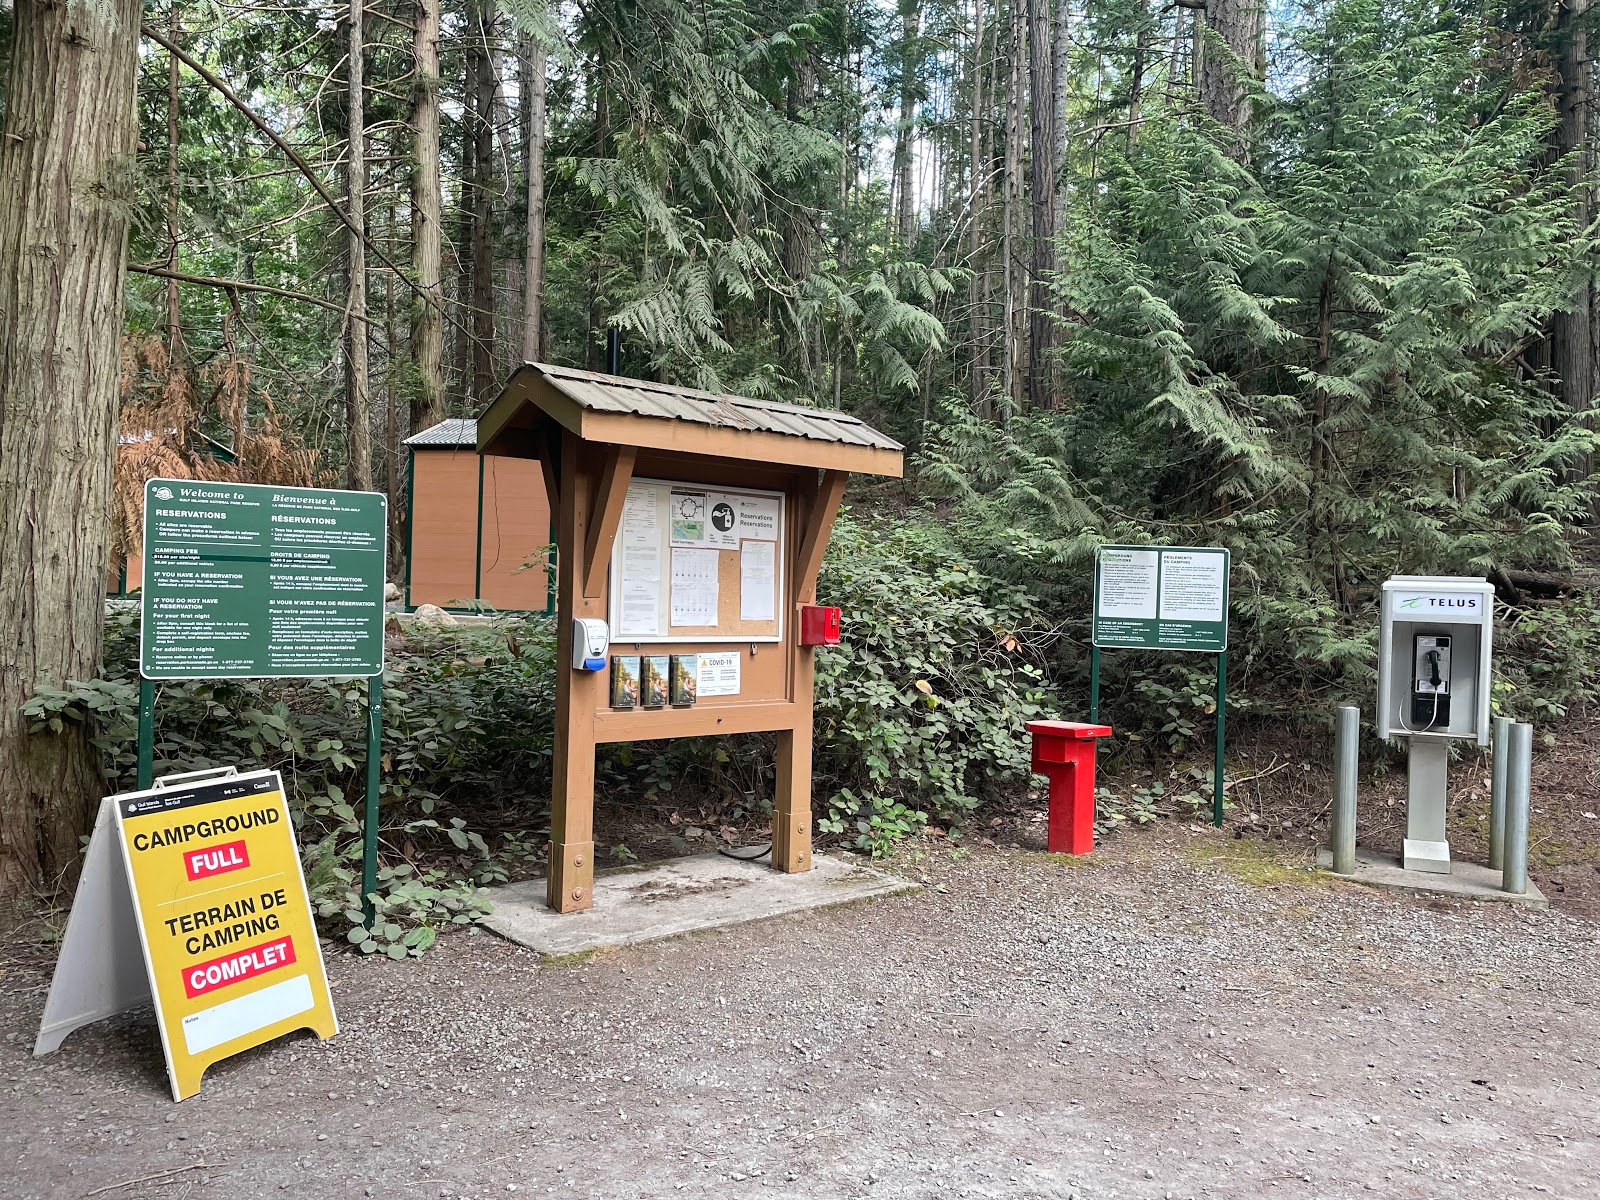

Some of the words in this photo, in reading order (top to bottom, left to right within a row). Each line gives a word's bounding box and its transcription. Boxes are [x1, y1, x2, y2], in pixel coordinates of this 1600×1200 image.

[180, 488, 230, 498] Welcome
[272, 494, 327, 504] Bienvenue
[156, 509, 226, 519] RESERVATIONS
[272, 515, 336, 524] RÉSERVATIONS
[1429, 598, 1475, 607] TELUS
[134, 808, 280, 851] CAMPGROUND
[191, 848, 243, 874] FULL
[165, 900, 256, 936] TERRAIN
[260, 889, 287, 910] DE
[185, 914, 280, 955] CAMPING
[190, 942, 287, 990] COMPLET
